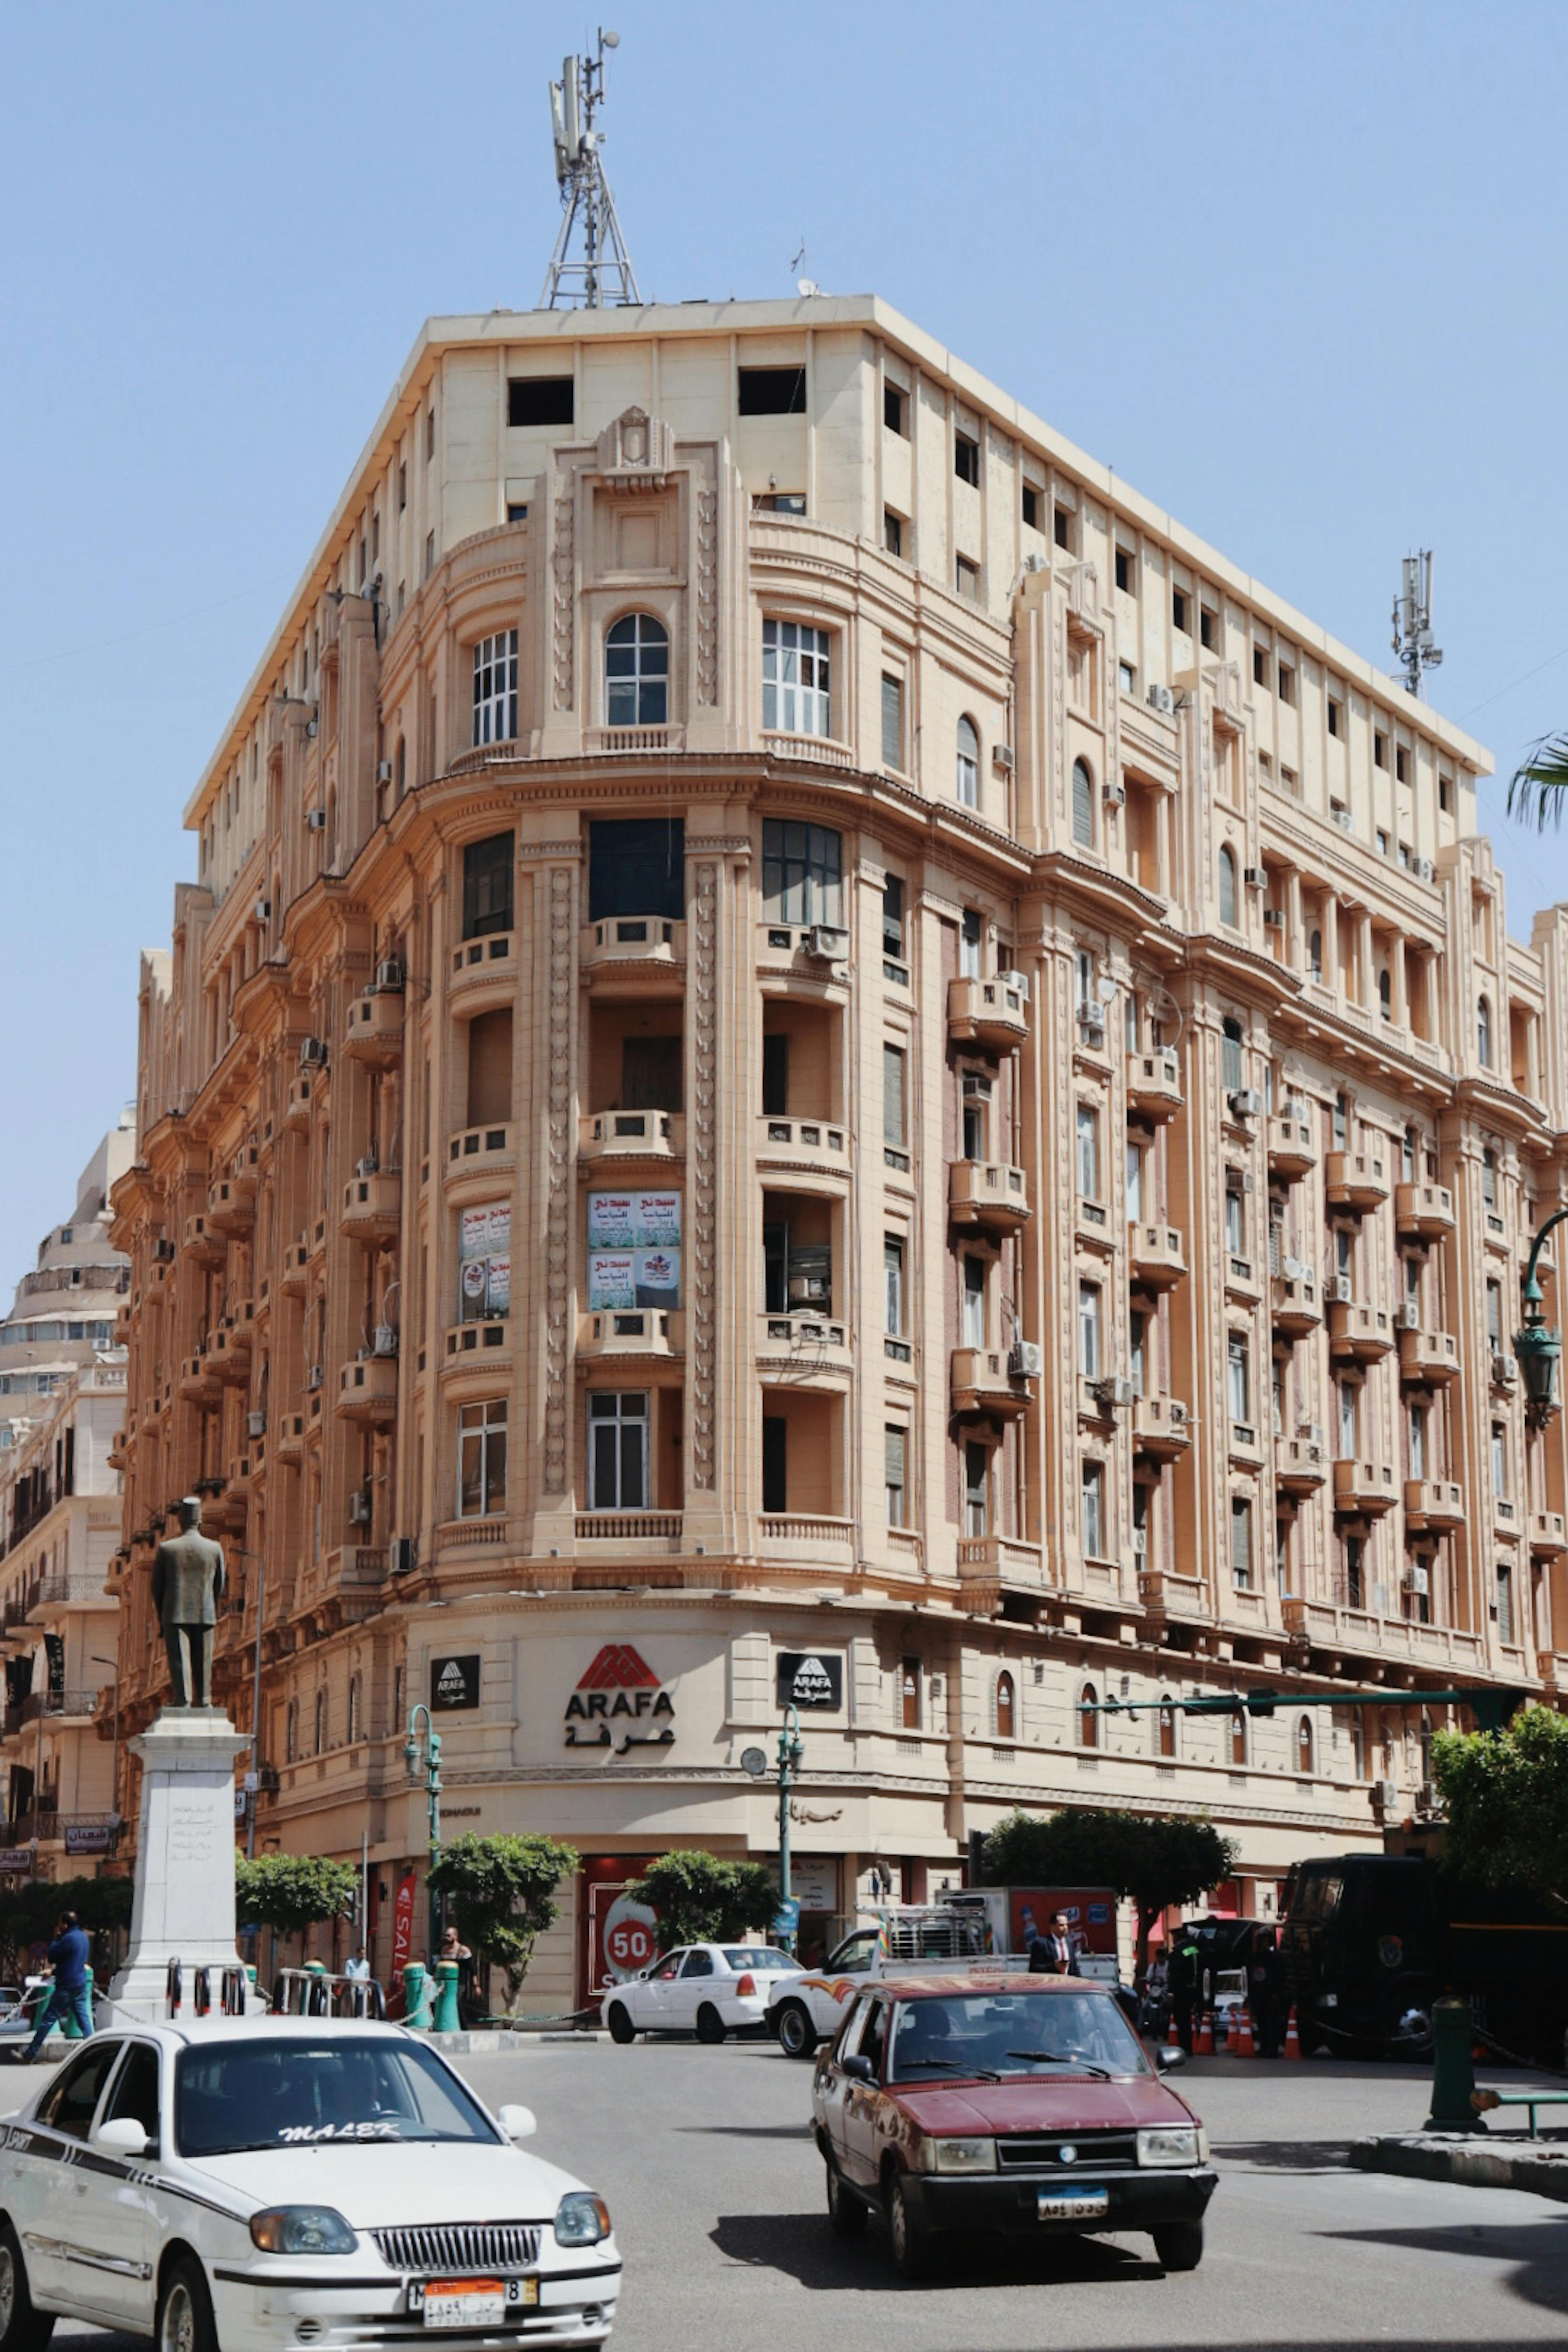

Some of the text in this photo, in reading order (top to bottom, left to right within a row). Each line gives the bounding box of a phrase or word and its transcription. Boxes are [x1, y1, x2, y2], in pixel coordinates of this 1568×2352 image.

[794, 1675, 832, 1688] ARAFA
[565, 1692, 675, 1720] ARAFA
[613, 1932, 647, 1958] 50
[278, 2122, 401, 2142] MALEK
[509, 2281, 518, 2300] 8
